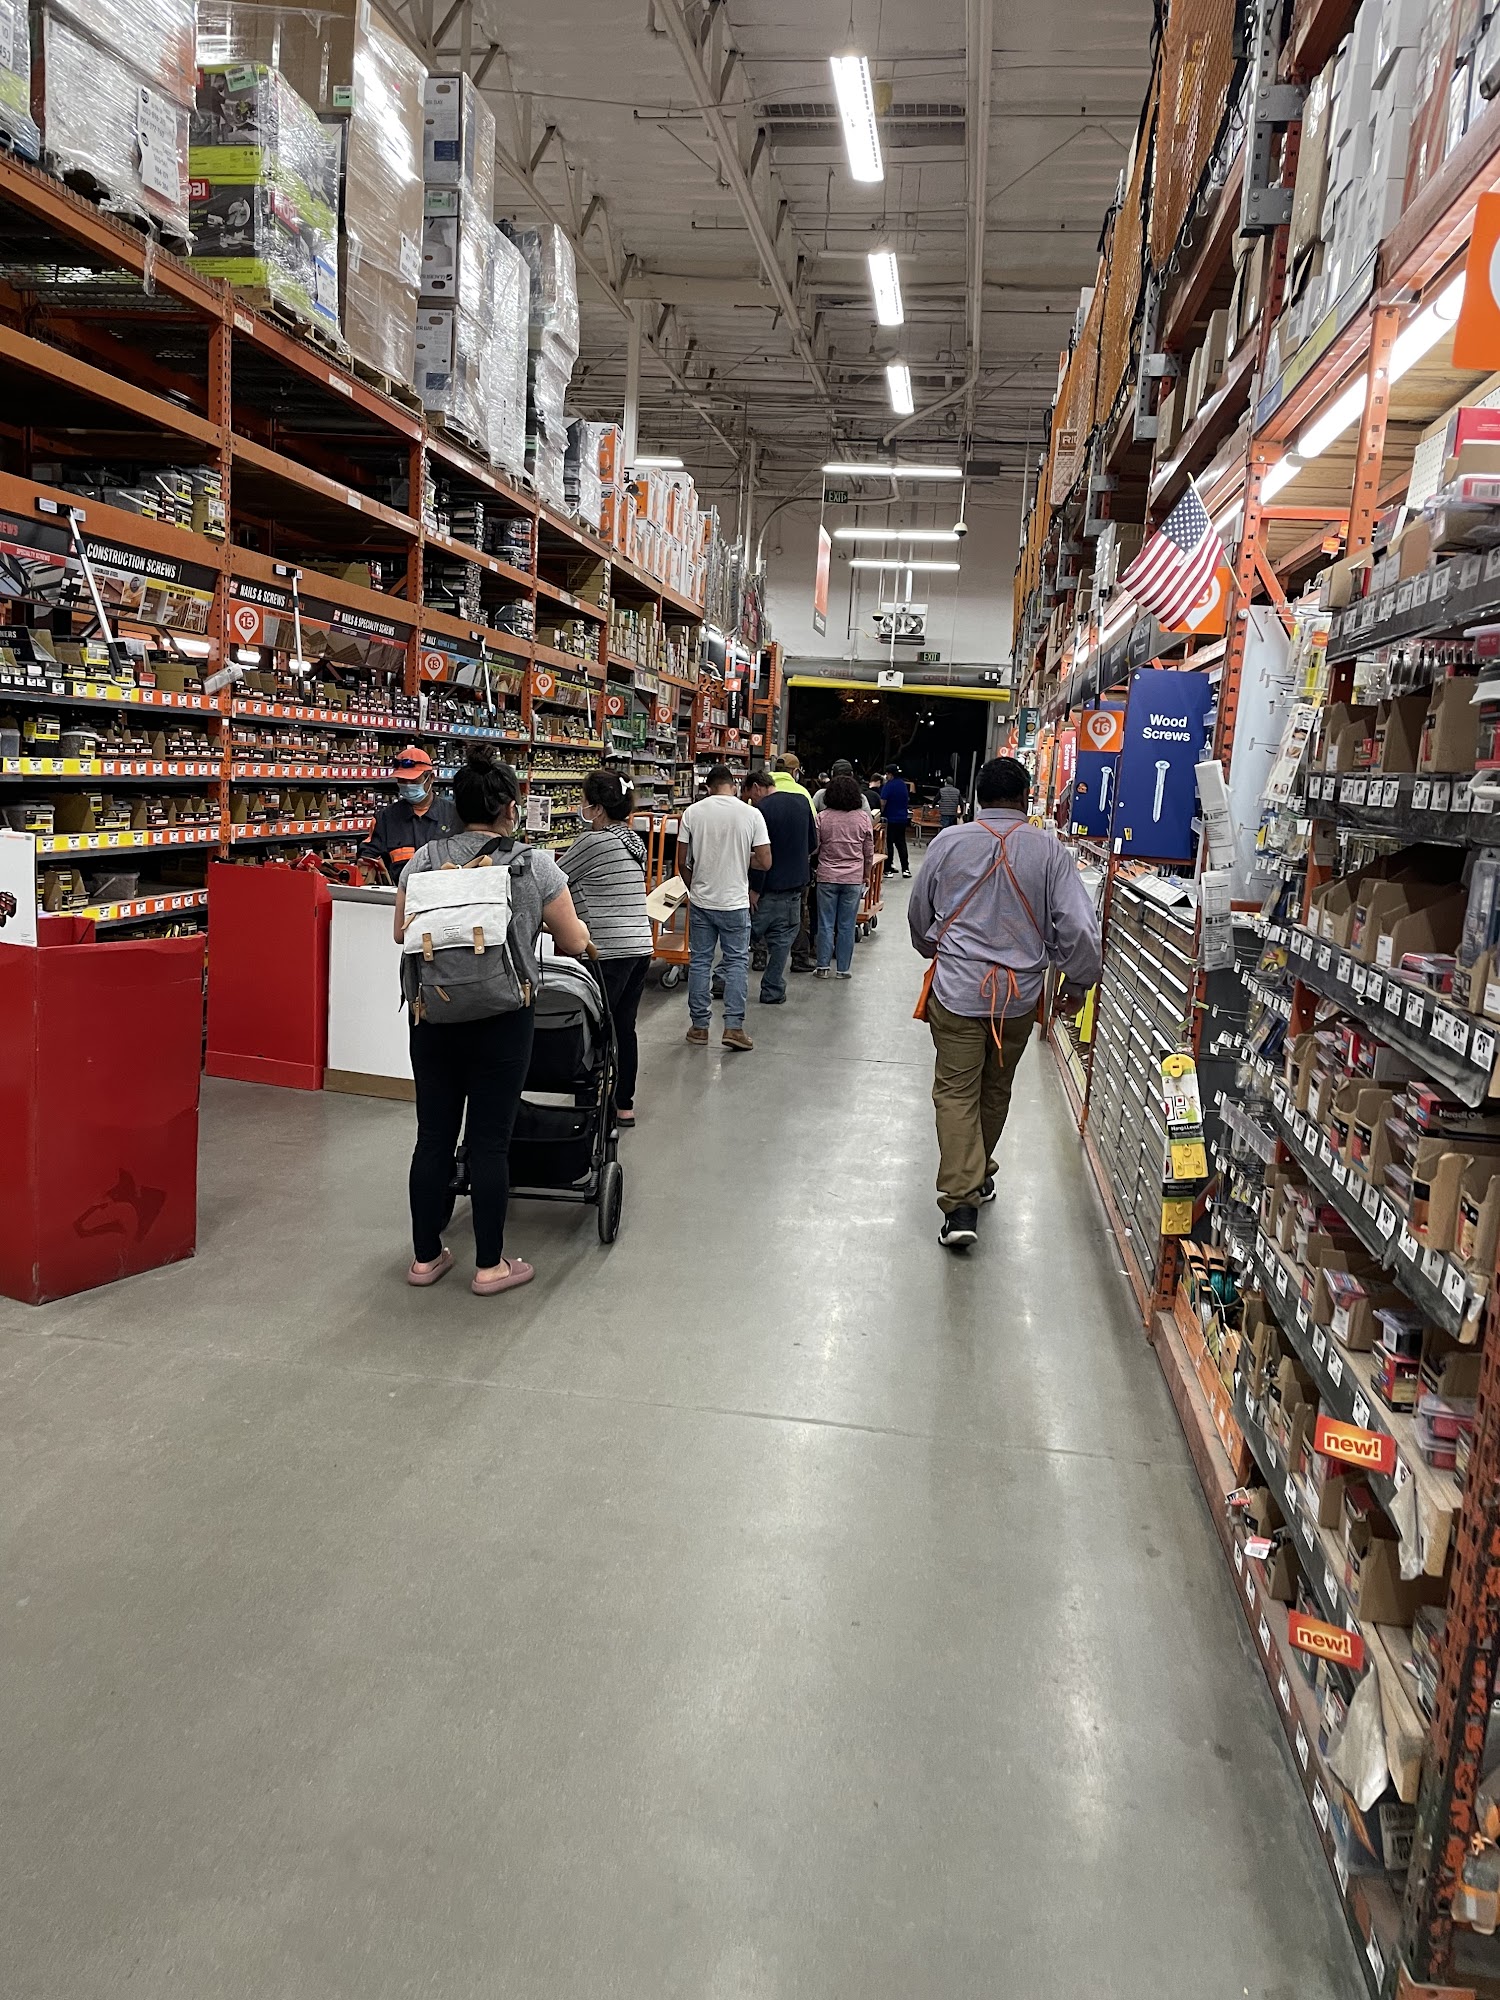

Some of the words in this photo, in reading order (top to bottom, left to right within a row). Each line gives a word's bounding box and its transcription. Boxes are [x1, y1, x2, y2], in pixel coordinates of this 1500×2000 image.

[828, 491, 845, 503] EXIT
[87, 542, 145, 571] CONSTRUCTION
[146, 559, 176, 579] SCREWS
[239, 584, 257, 601] NAILS
[257, 588, 263, 602] &
[262, 590, 286, 608] SCREWS
[240, 617, 254, 628] 15
[429, 660, 440, 669] 13
[923, 652, 938, 662] EXIT
[1094, 722, 1110, 733] 16
[1150, 713, 1187, 728] Wood
[1142, 727, 1191, 742] Screws
[1326, 1434, 1380, 1458] new!
[1298, 1627, 1350, 1656] new!
